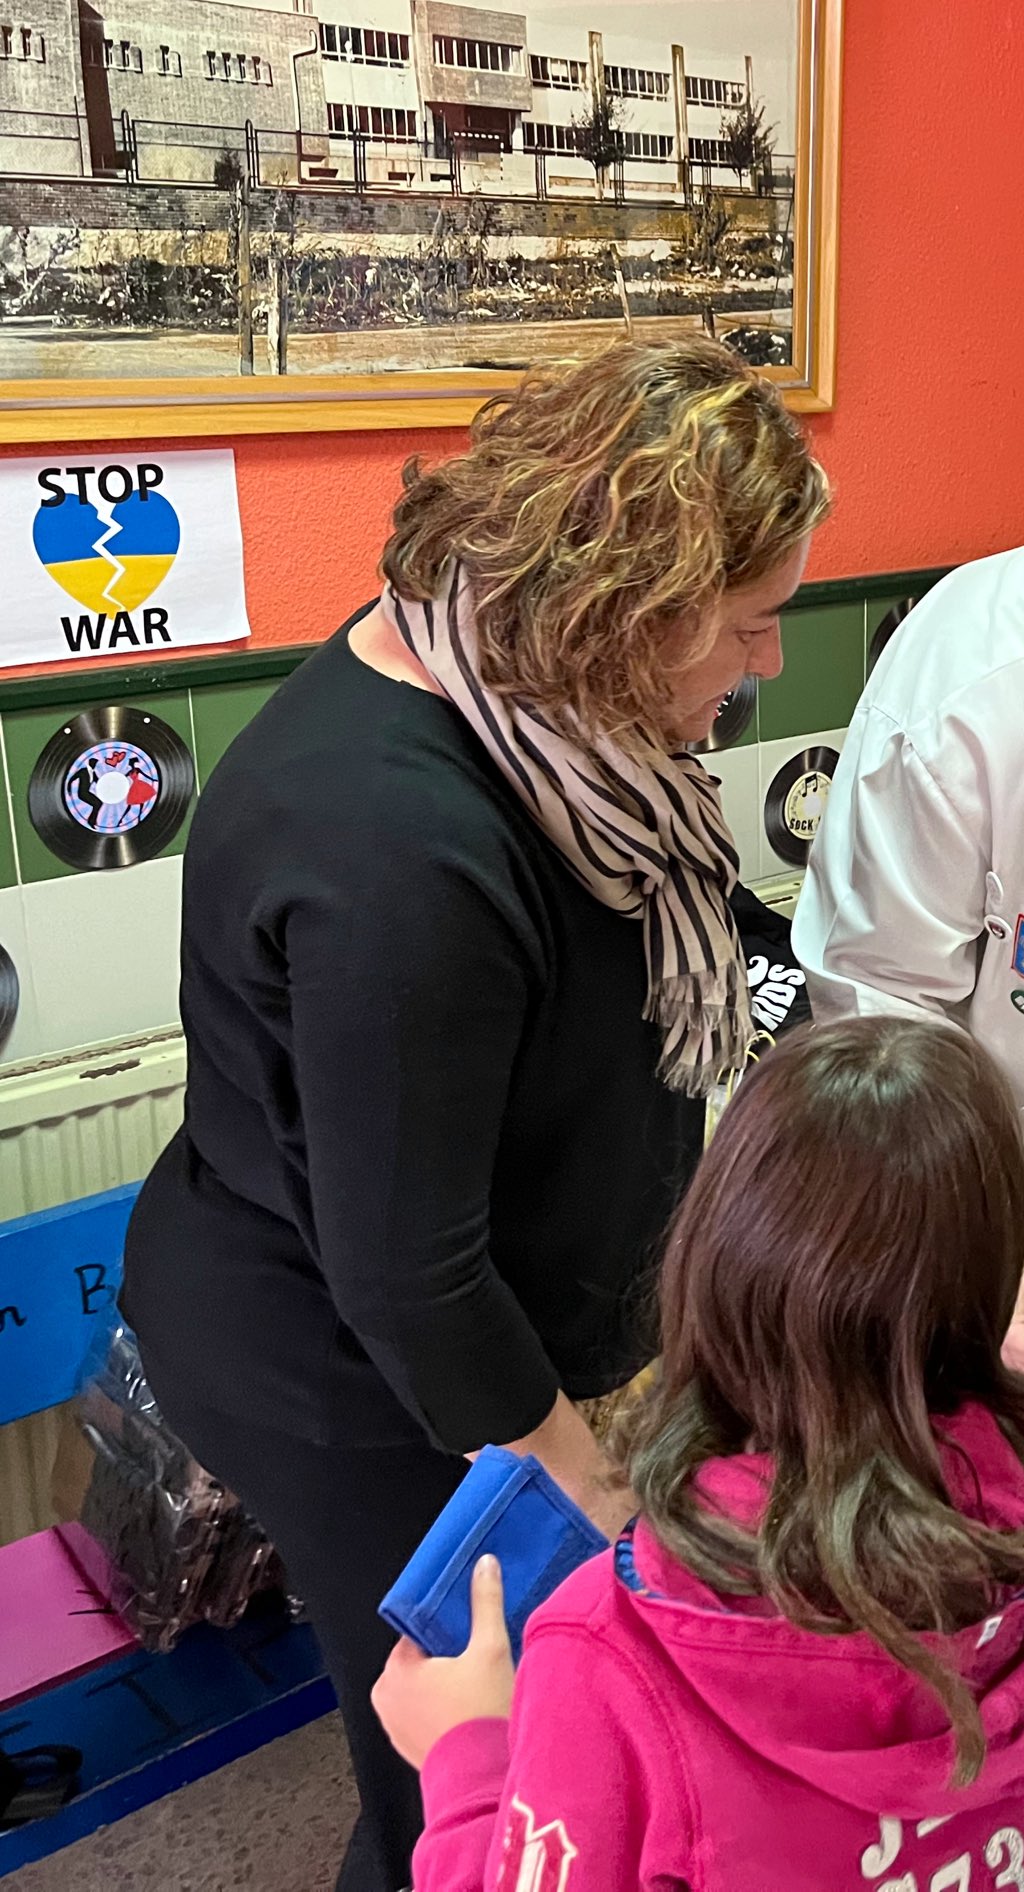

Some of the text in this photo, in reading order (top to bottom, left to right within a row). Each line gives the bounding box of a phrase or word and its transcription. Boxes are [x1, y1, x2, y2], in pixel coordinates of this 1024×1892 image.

[37, 463, 164, 508] STOP
[60, 607, 172, 652] WAR
[789, 818, 814, 831] SOCK
